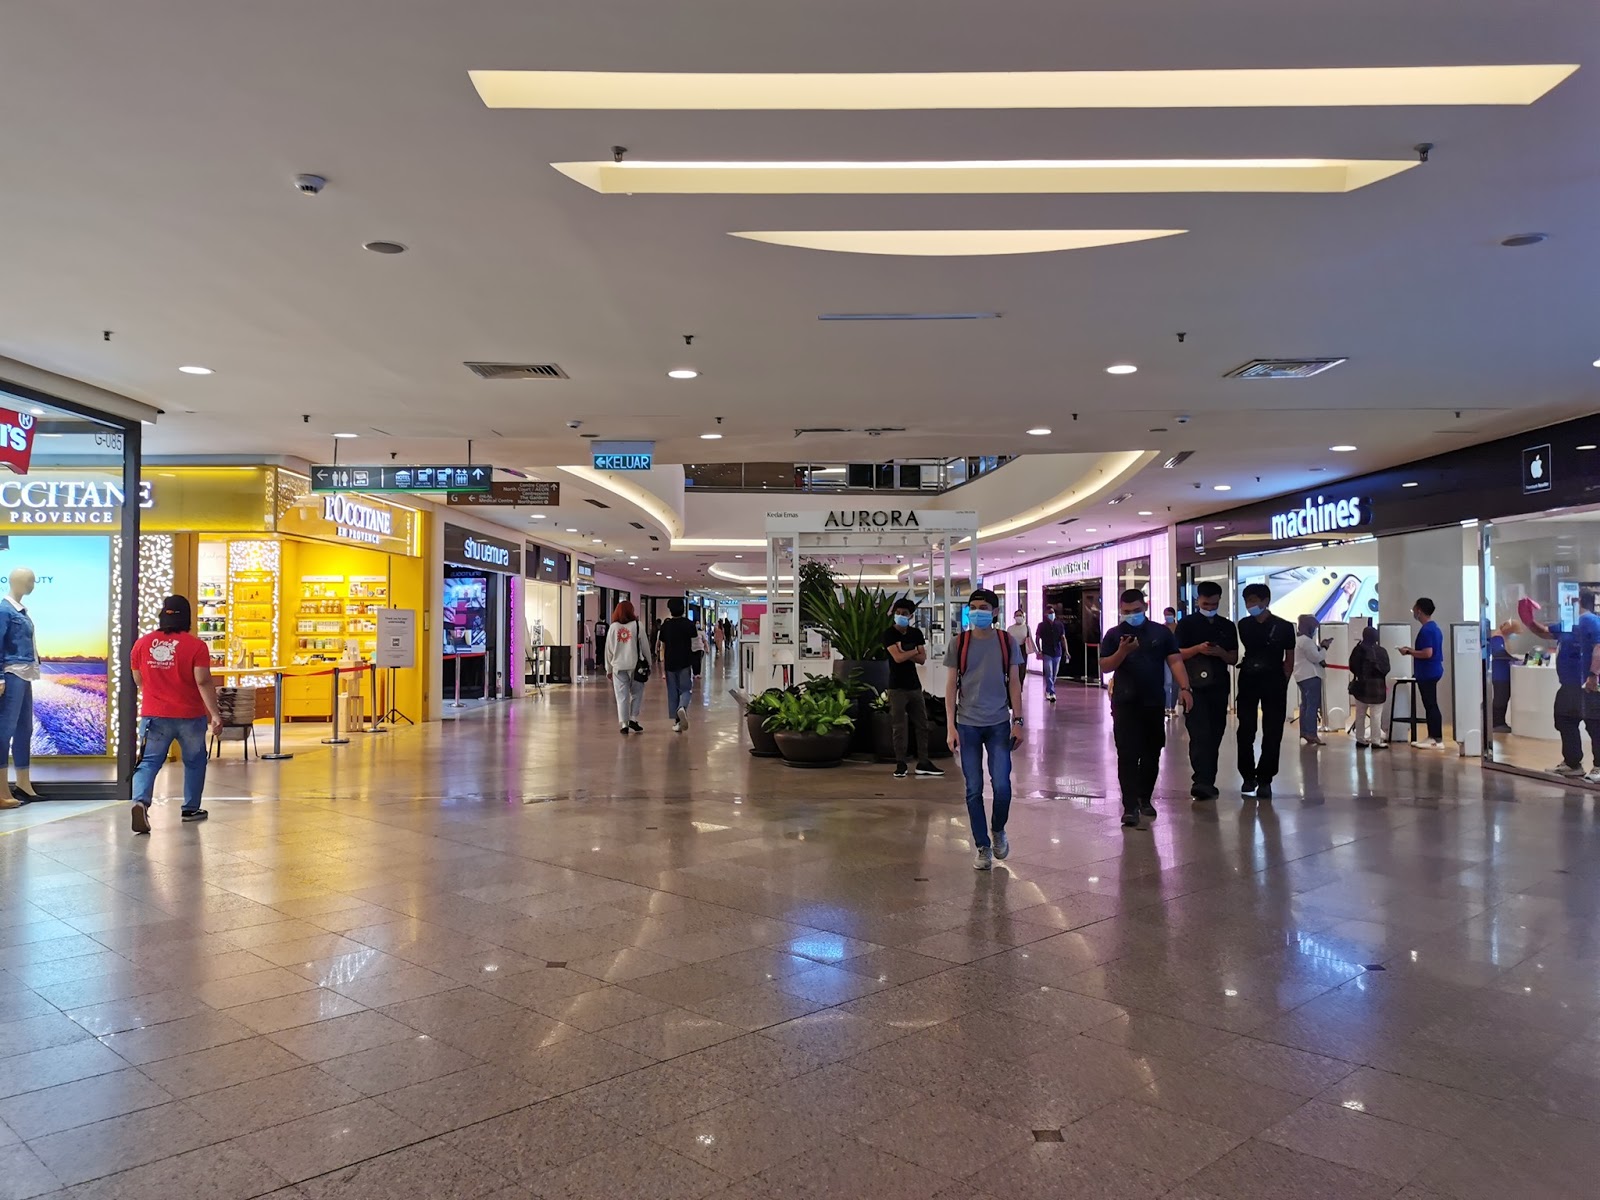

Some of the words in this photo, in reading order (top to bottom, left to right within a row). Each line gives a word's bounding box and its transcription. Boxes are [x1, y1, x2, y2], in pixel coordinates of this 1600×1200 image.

[605, 456, 650, 469] KELUAR
[9, 511, 113, 523] PROVENCE
[824, 510, 919, 527] AURORA
[1271, 495, 1361, 540] machines
[349, 529, 380, 544] PROVENCE
[464, 536, 481, 560] shu
[481, 544, 509, 566] uemura
